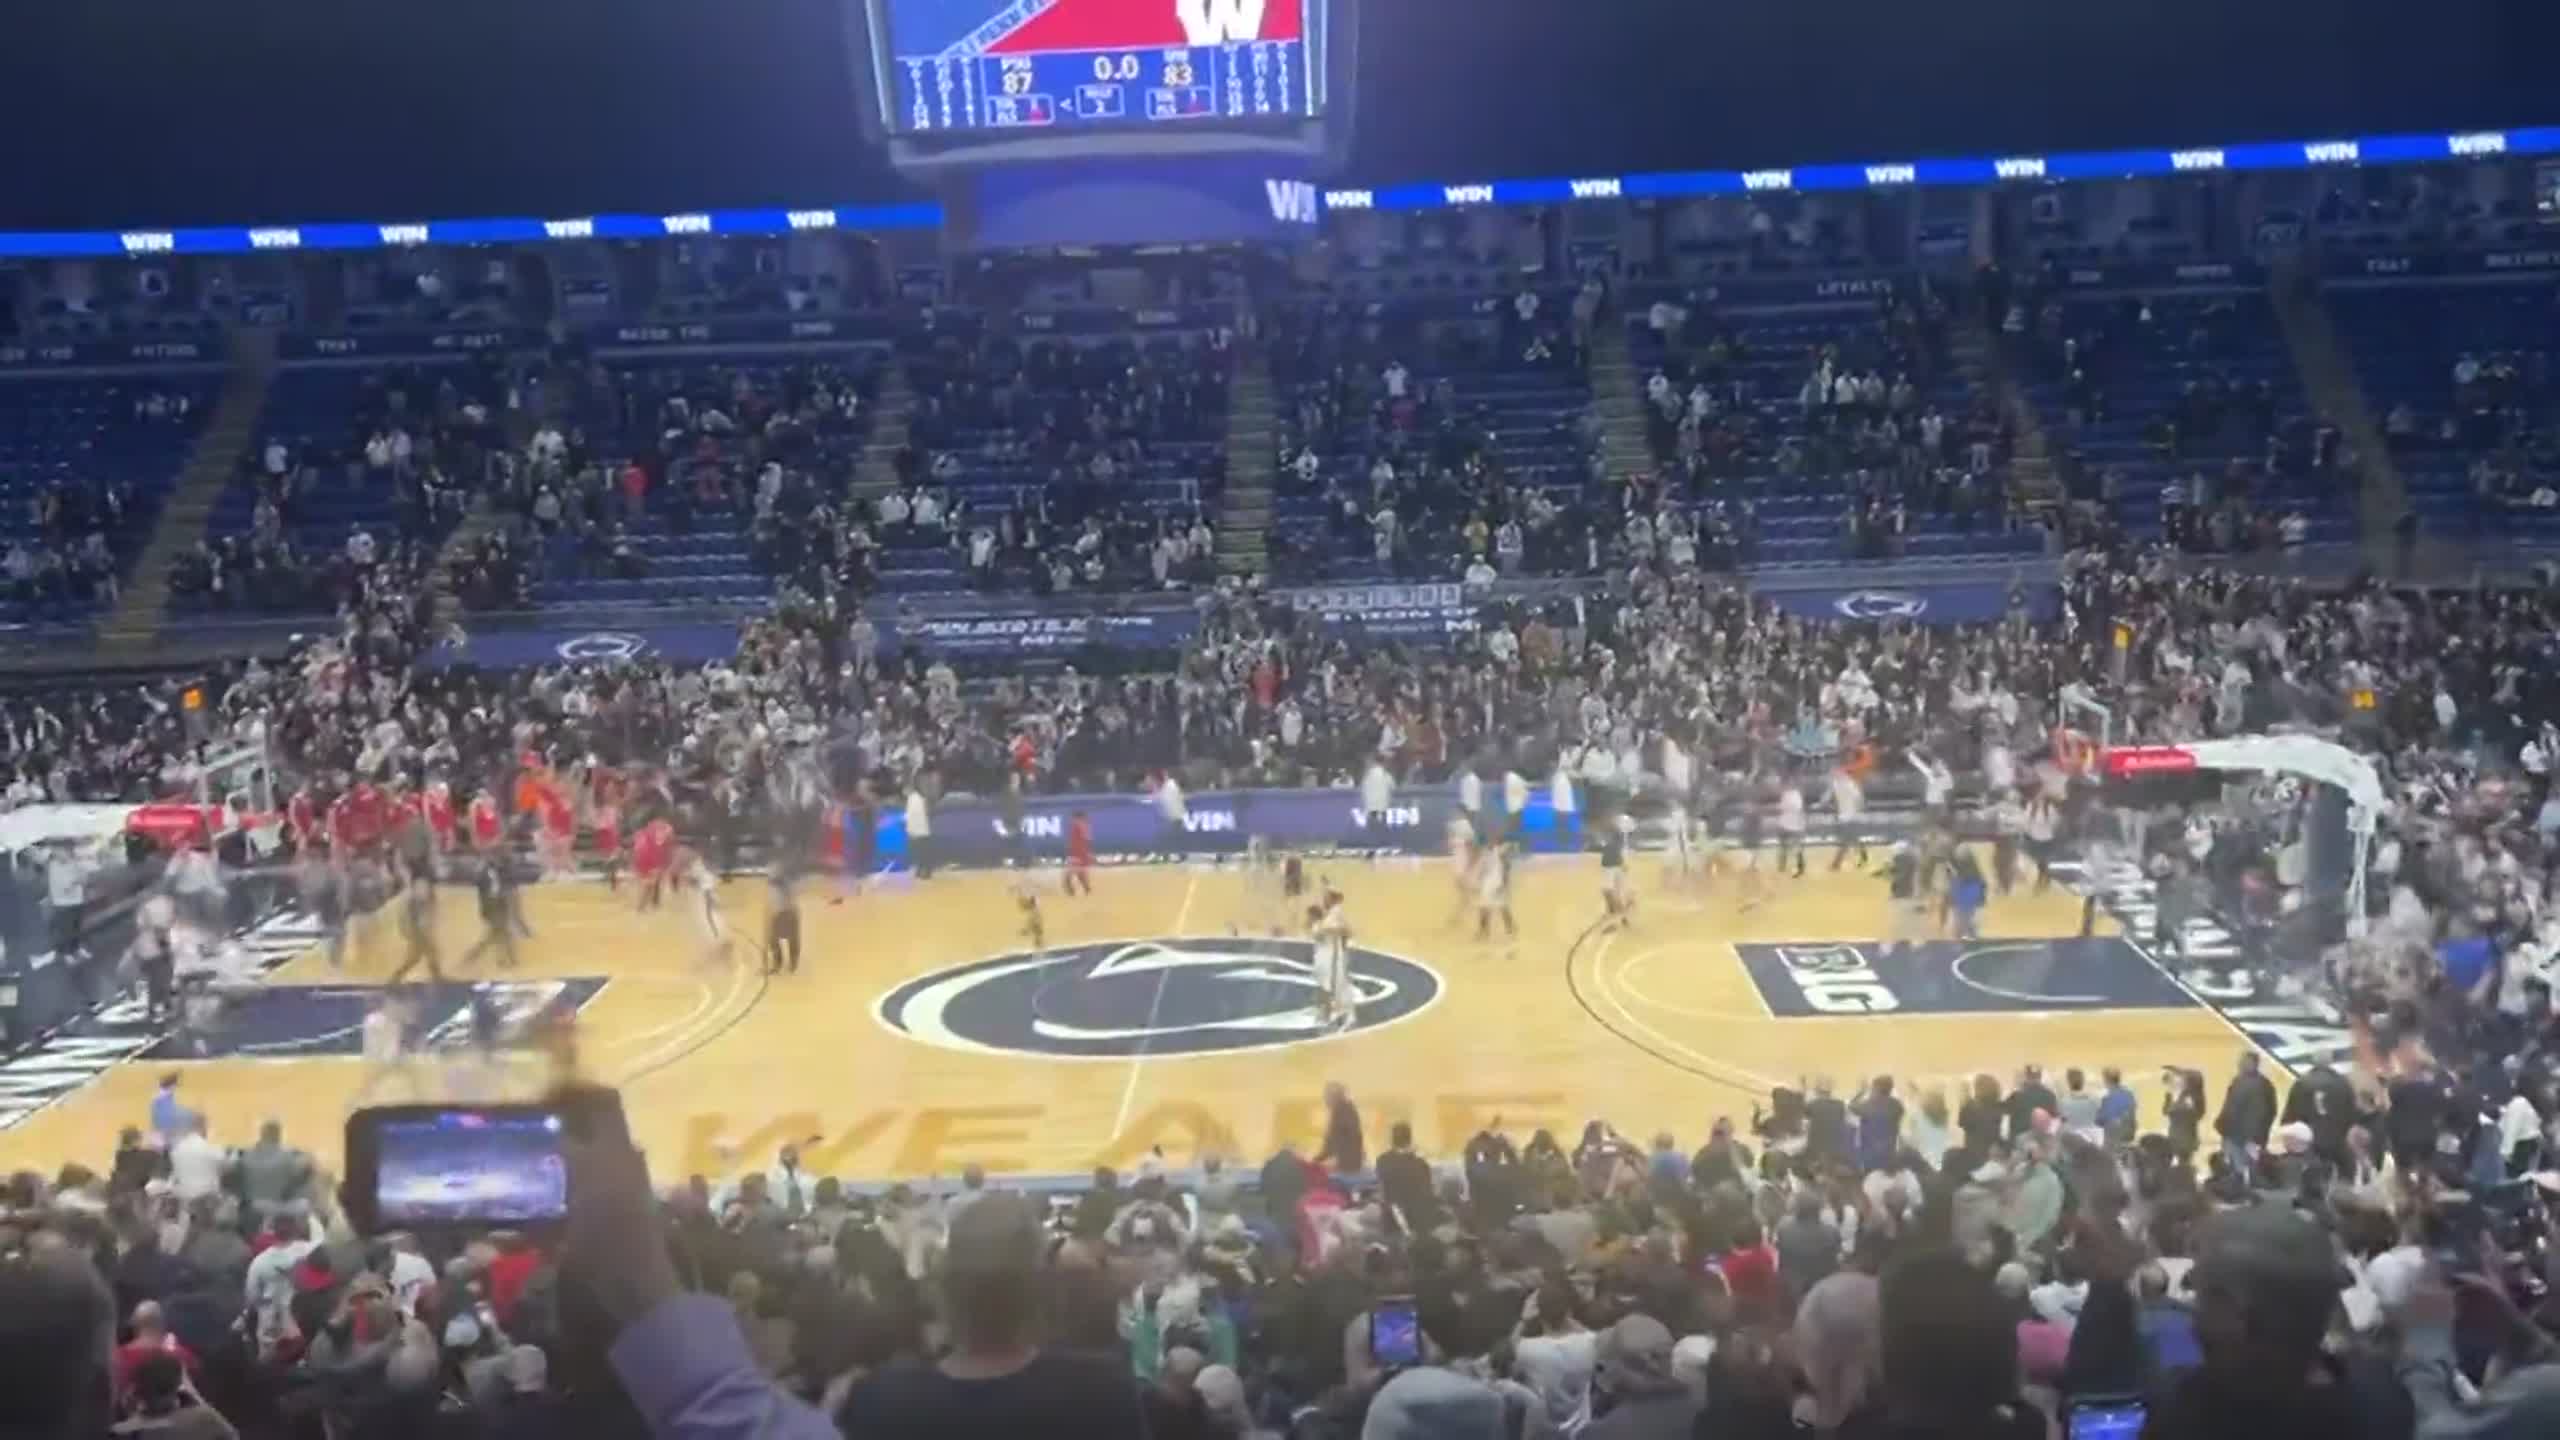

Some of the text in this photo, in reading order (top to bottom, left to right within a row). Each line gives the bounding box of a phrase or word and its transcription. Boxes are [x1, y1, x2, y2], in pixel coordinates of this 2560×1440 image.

[1094, 55, 1138, 80] 0.0
[1164, 63, 1192, 86] 83
[1003, 71, 1032, 94] 87
[1325, 133, 2505, 208] WIN WIN WIN WIN WIN WIN WIN WIN WIN
[121, 211, 836, 251] WIN WIN WIN WIN WIN WIN
